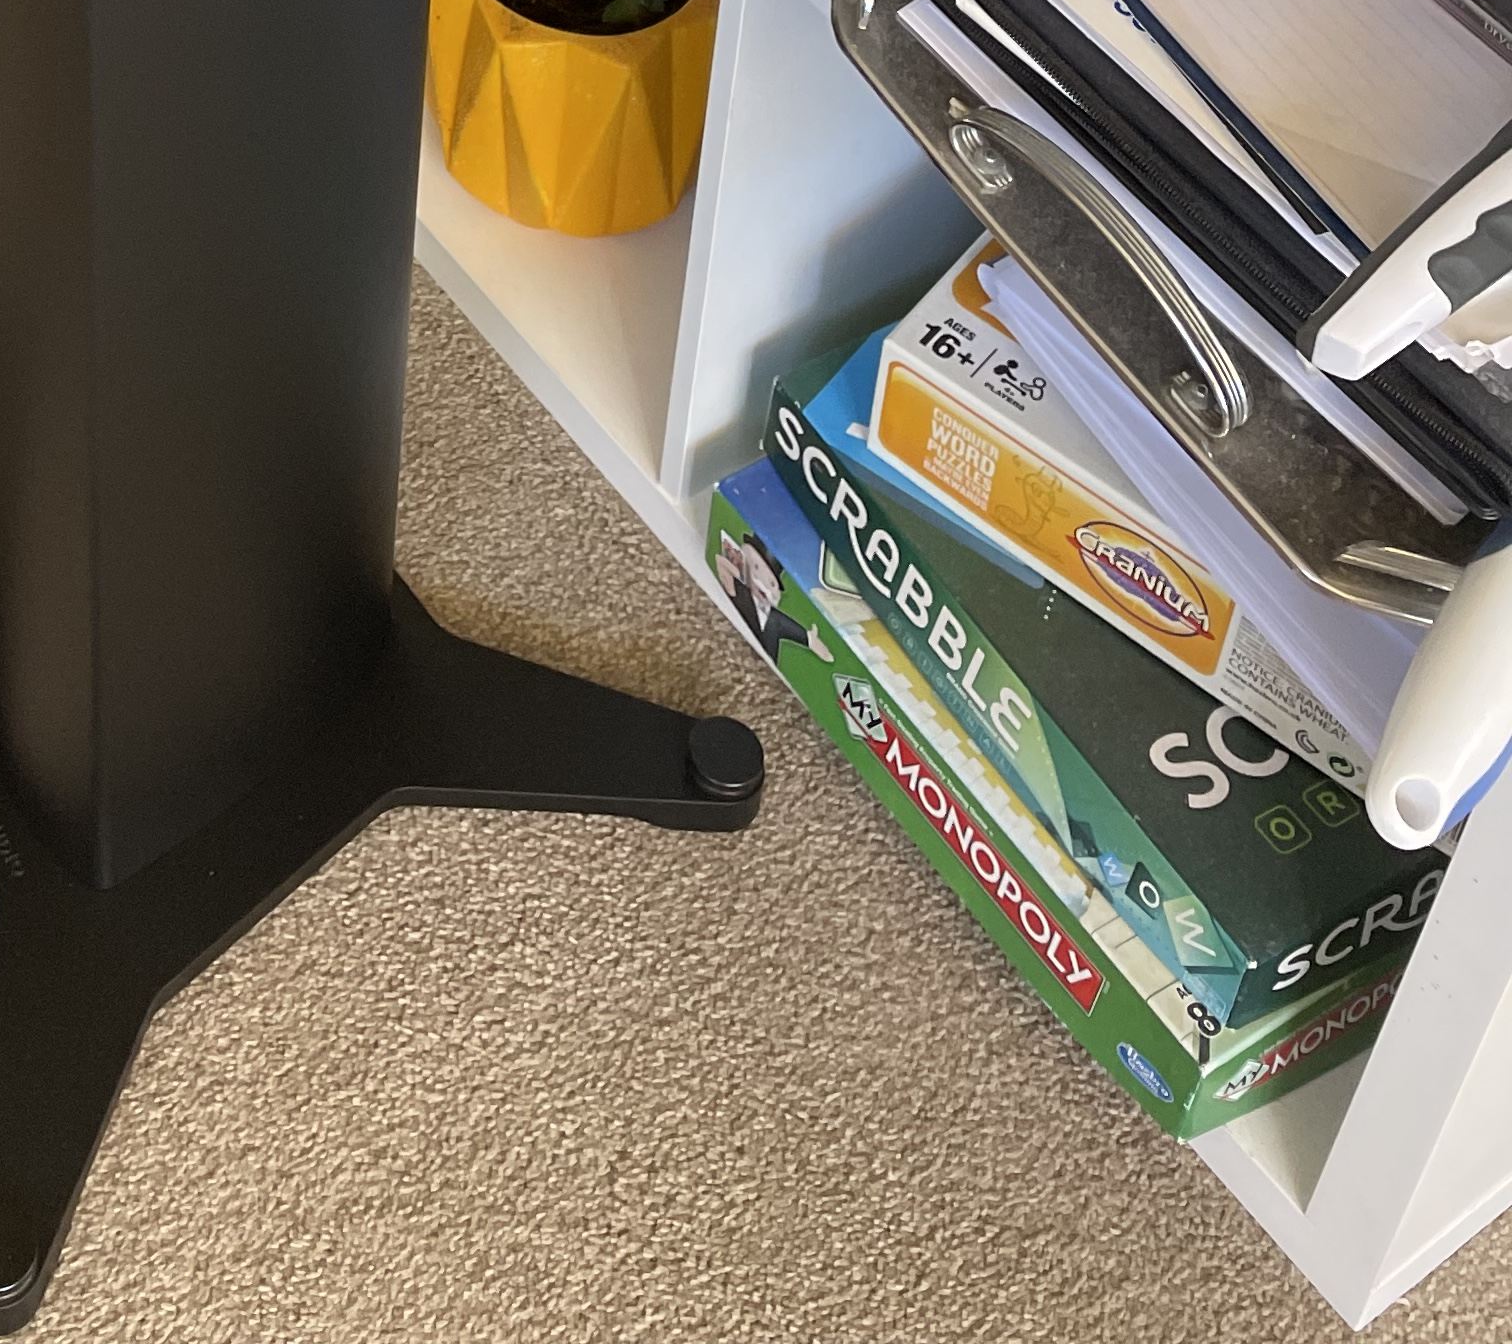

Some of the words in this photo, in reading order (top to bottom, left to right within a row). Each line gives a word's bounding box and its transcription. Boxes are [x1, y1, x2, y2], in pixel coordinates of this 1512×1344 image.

[919, 324, 974, 365] 16+
[944, 318, 976, 341] AGES
[984, 382, 1025, 411] PLAYERS
[932, 419, 996, 477] WORD
[934, 407, 999, 460] CONQUER
[927, 437, 992, 492] PUZZLES
[775, 407, 1032, 752] SCRABBLE
[842, 683, 882, 729] MY
[1229, 658, 1296, 709] CONTAINS
[886, 738, 1091, 983] MONOPOLY
[1223, 1064, 1264, 1094] MY
